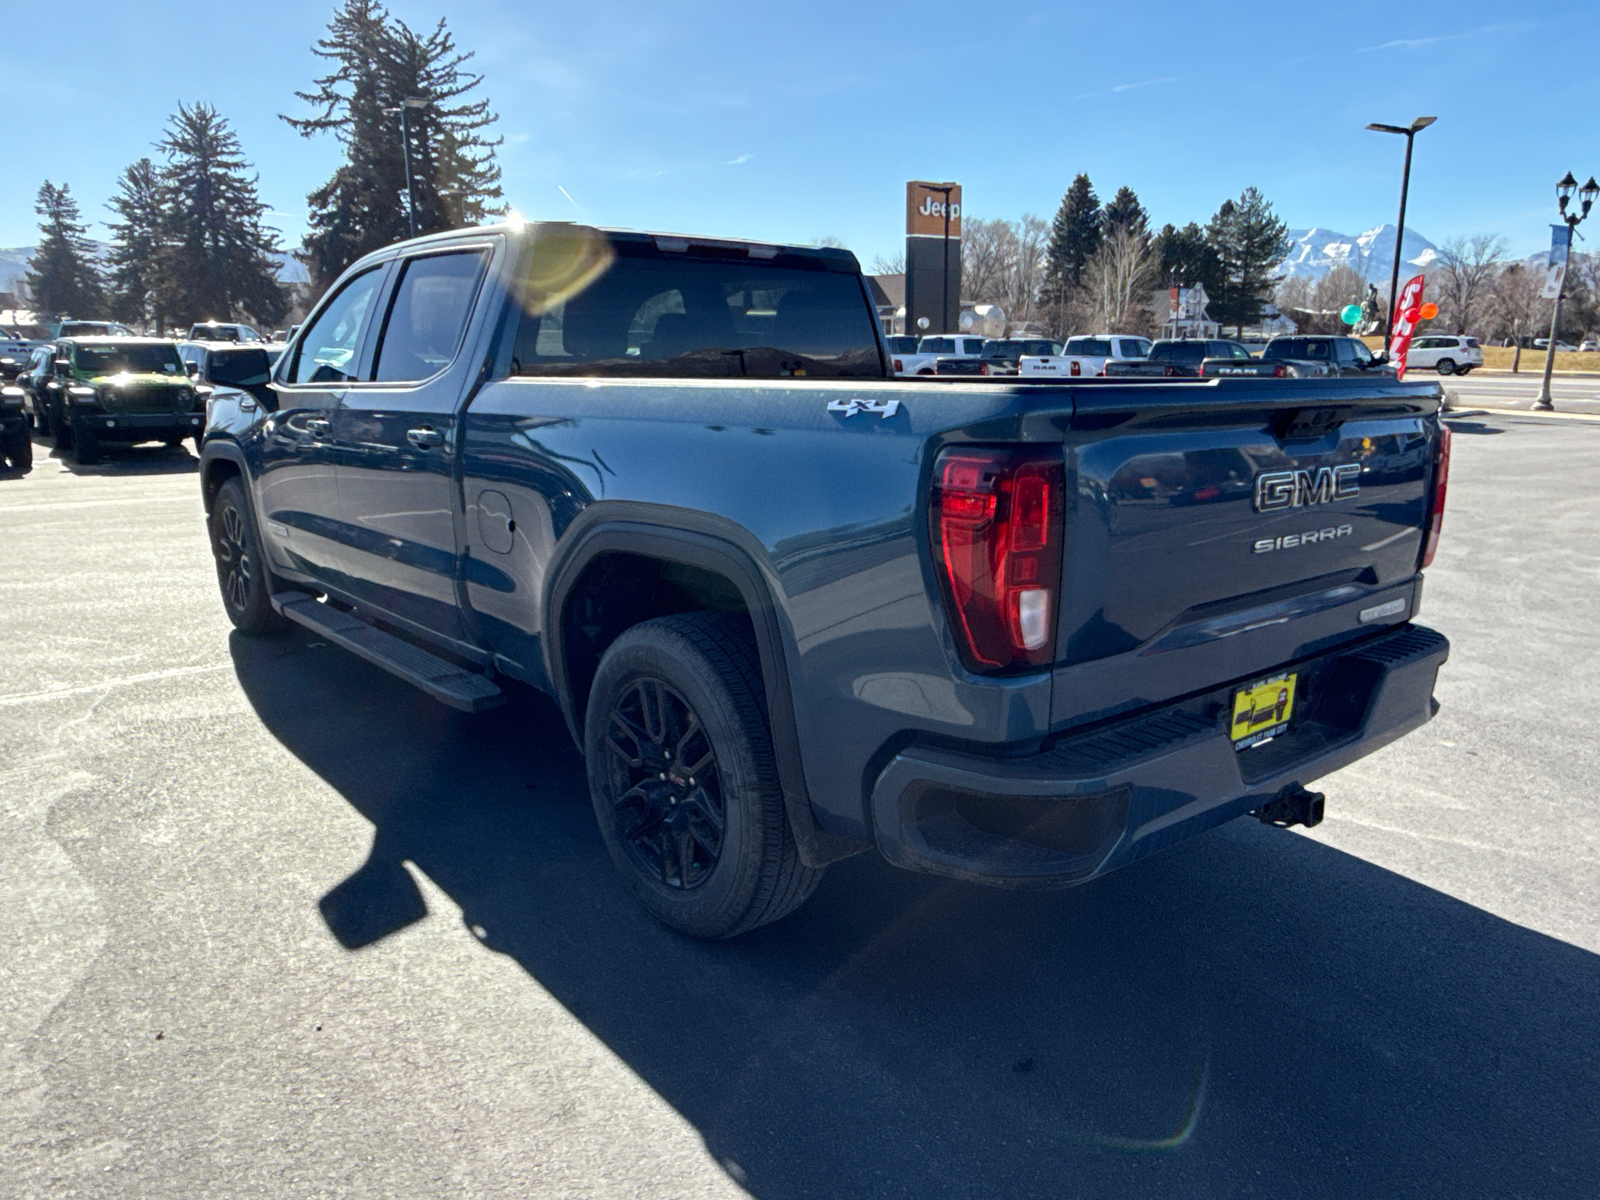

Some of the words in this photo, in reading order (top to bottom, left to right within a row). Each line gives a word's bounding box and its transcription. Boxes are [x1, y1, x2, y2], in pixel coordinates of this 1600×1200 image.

[919, 196, 960, 221] Jeep
[1256, 463, 1361, 513] GMC
[1254, 524, 1353, 553] SIERRA
